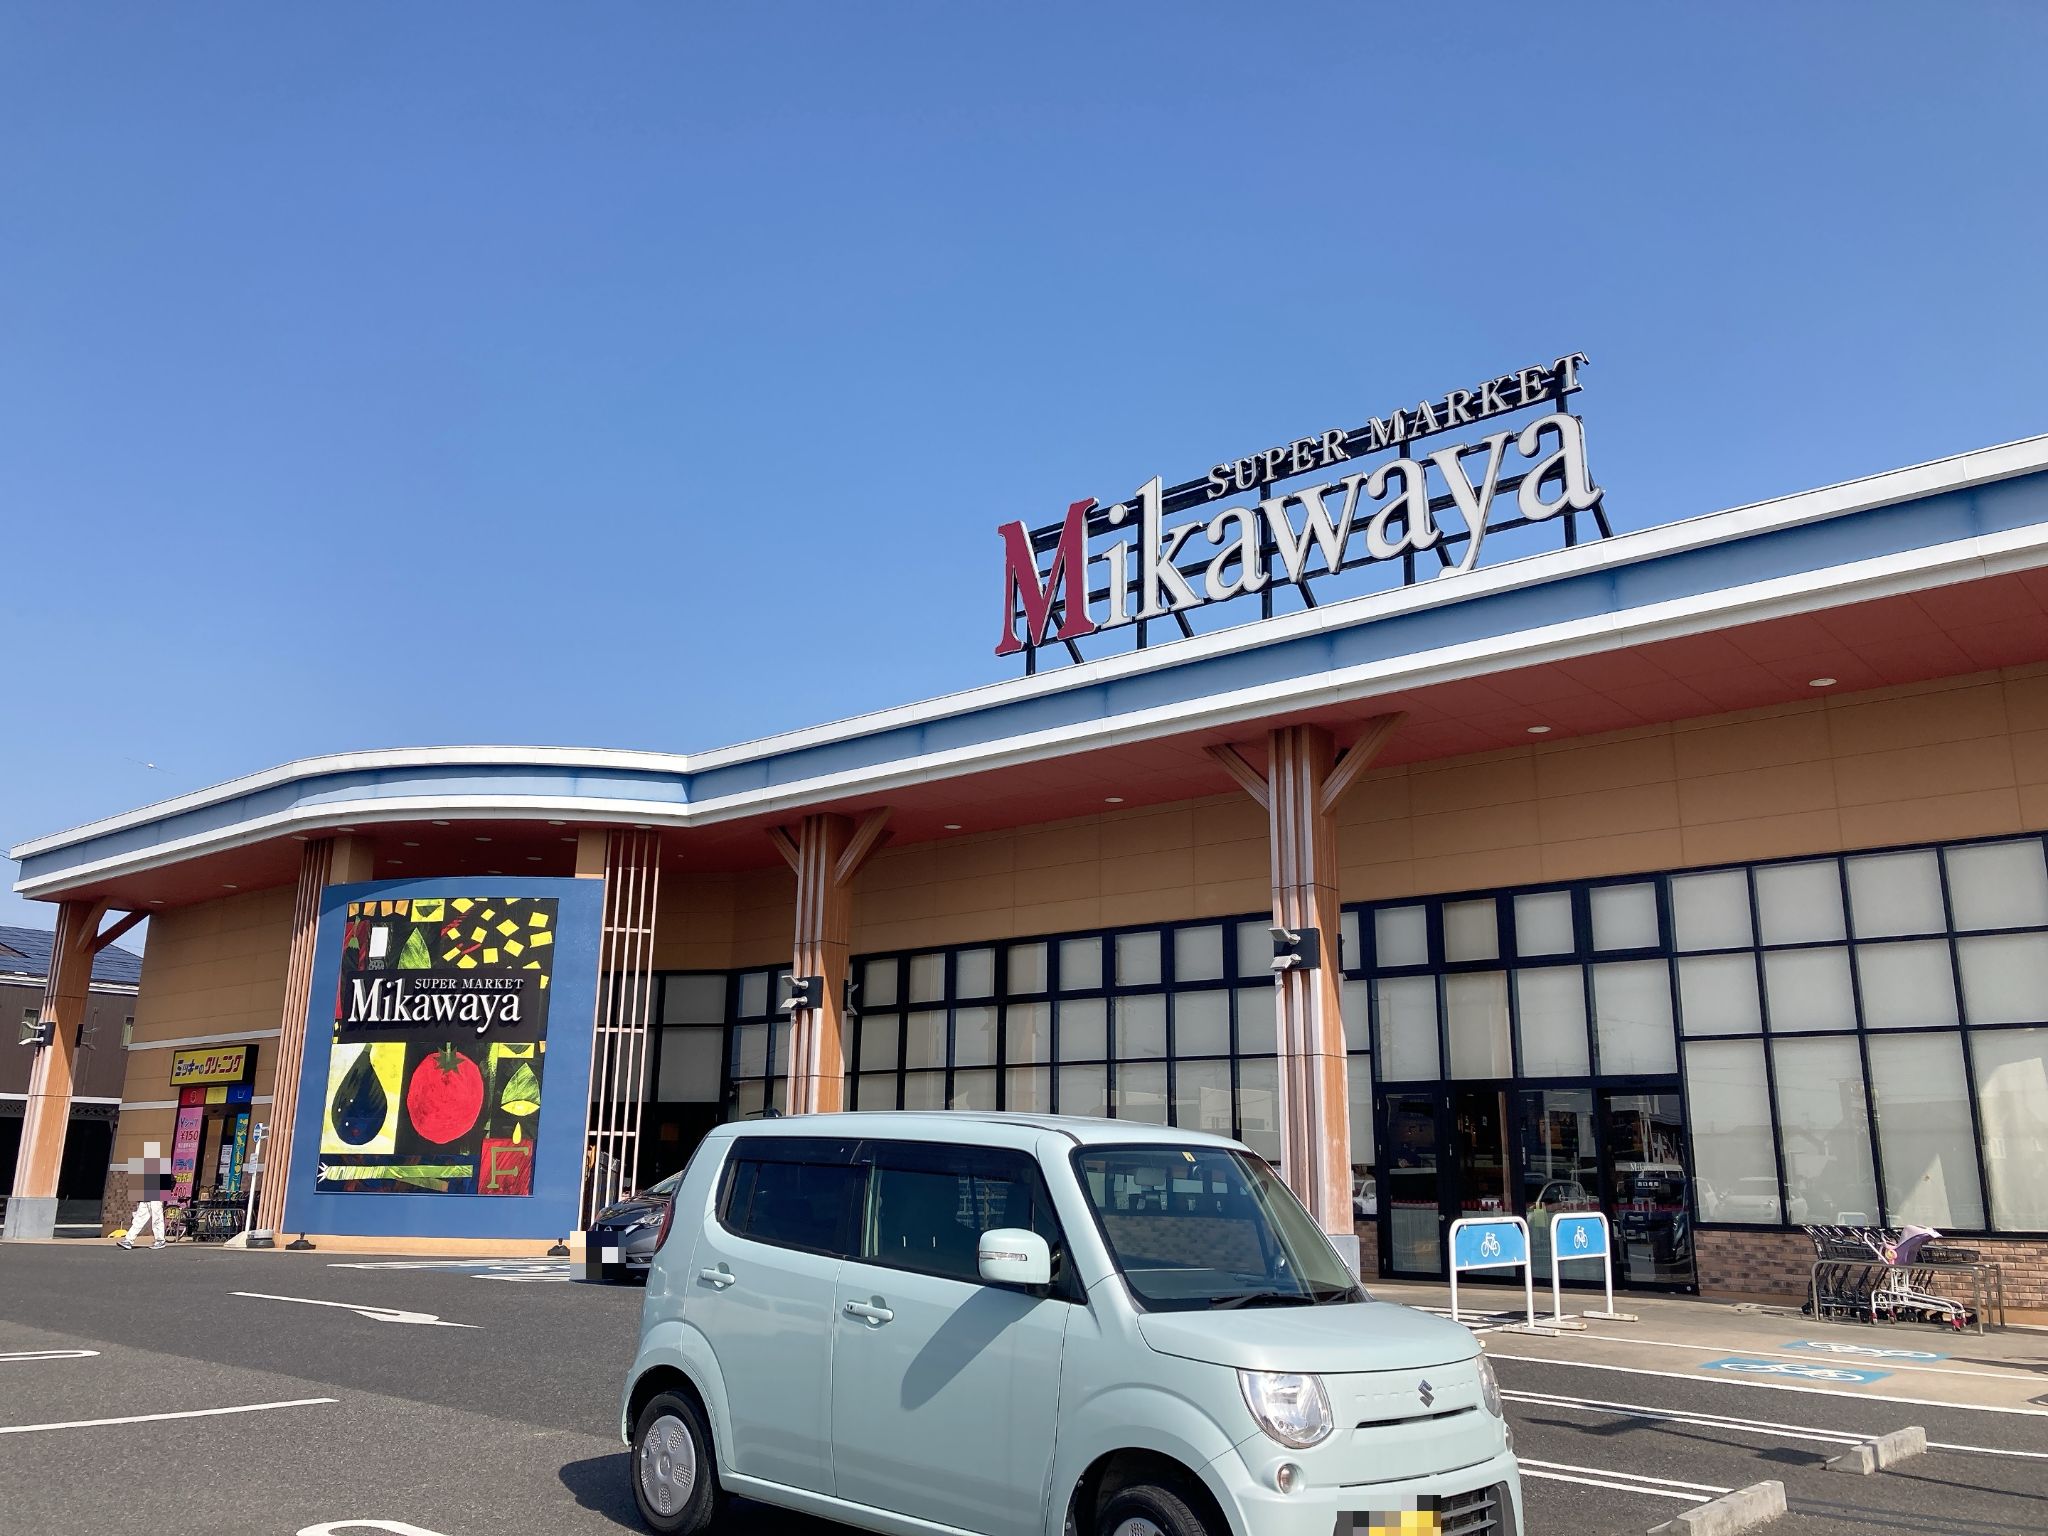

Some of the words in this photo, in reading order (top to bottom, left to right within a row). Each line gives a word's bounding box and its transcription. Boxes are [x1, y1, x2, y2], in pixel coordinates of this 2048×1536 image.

[1206, 428, 1351, 501] SUPER
[1366, 351, 1590, 452] MARKET
[995, 412, 1605, 657] Mikawaya
[348, 977, 522, 1034] Mikawaya
[414, 978, 457, 990] SUPER
[462, 978, 525, 990] MARKET
